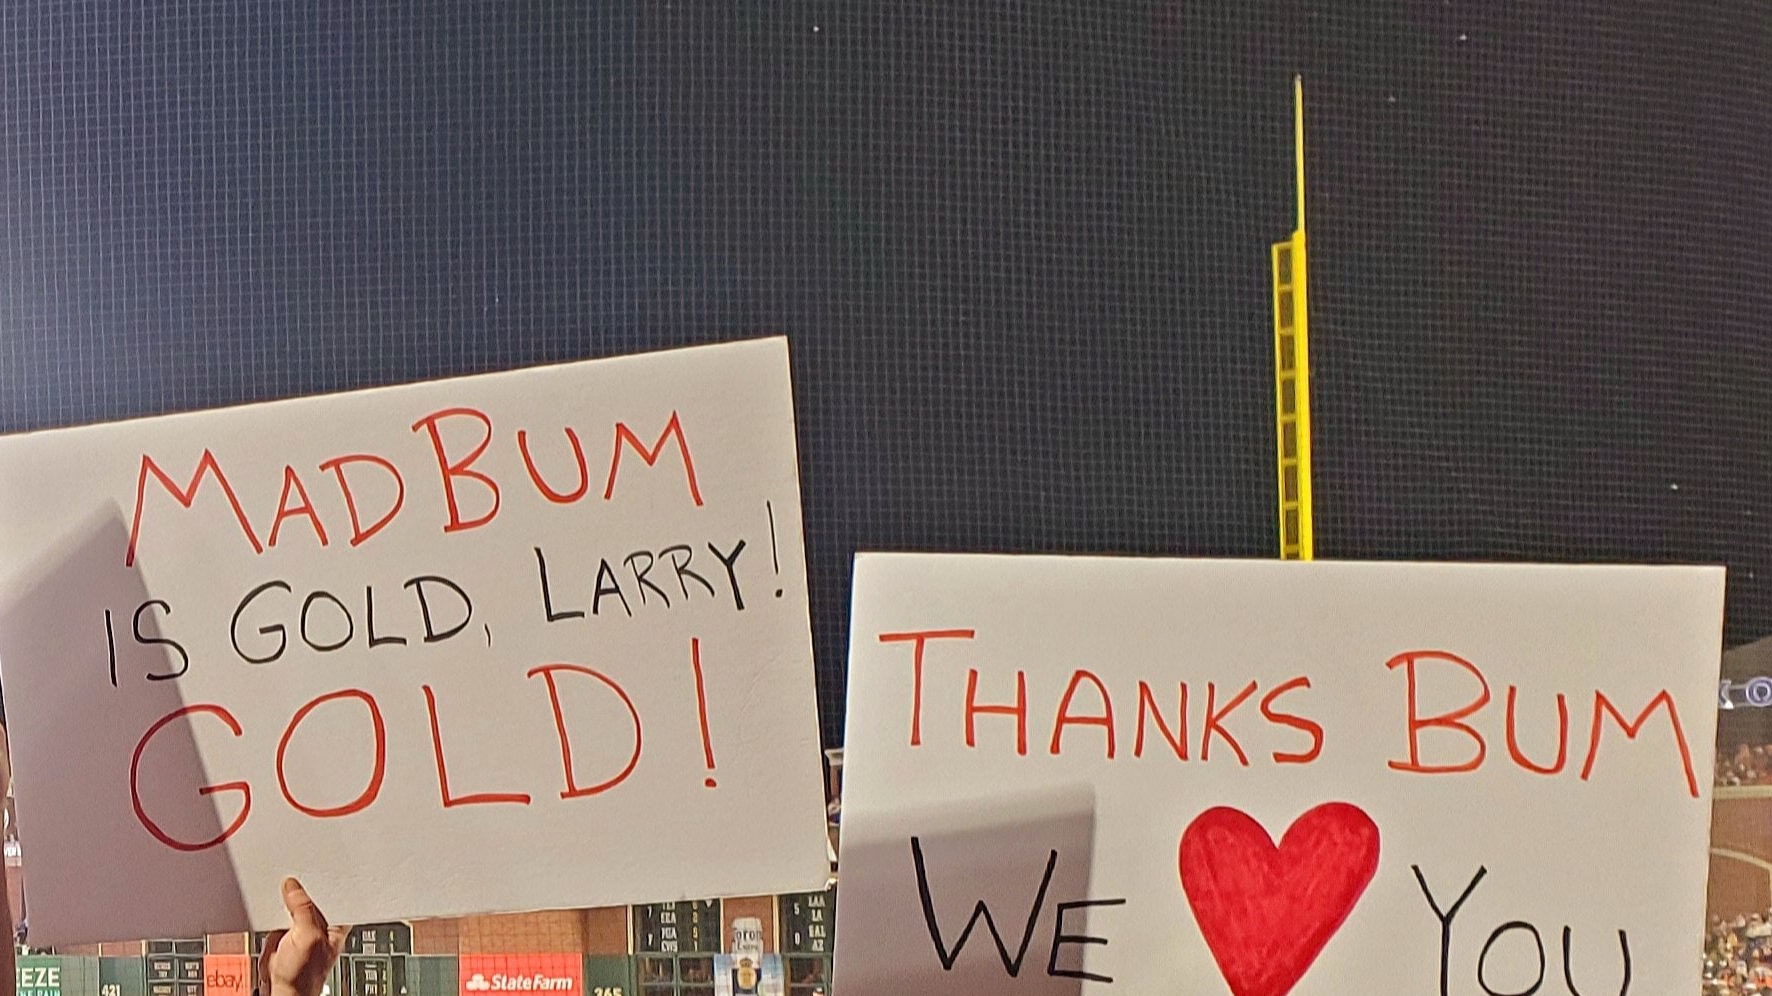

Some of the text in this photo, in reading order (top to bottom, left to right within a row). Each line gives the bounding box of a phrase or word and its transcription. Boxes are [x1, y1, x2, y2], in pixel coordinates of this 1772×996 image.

[126, 407, 703, 568] MADBUM
[105, 501, 783, 687] IS GOLD, LARRY!
[131, 637, 717, 851] GOLD!
[879, 630, 1699, 798] THANKS BUM
[207, 972, 242, 992] ebay
[911, 836, 1126, 983] WE
